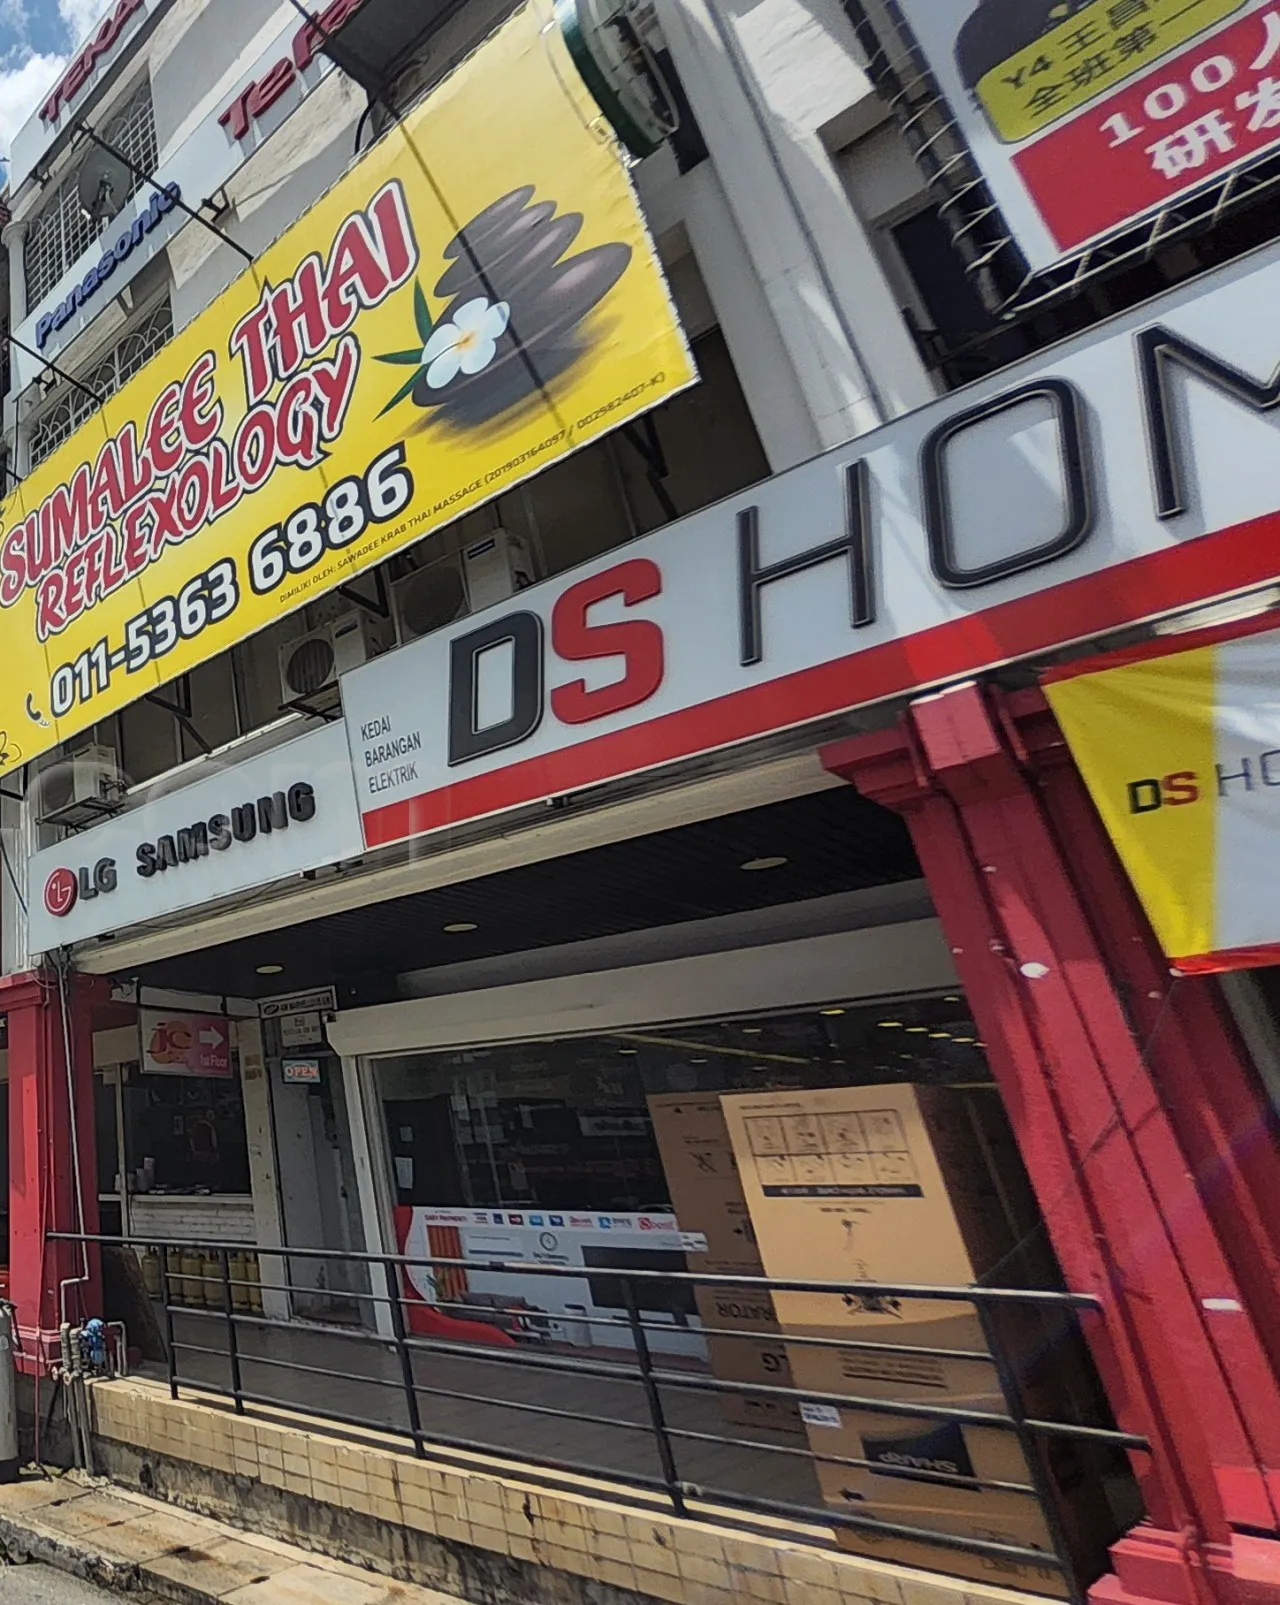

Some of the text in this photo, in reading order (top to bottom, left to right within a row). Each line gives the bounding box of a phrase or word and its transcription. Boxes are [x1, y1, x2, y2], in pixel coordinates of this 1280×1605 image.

[35, 181, 182, 349] Panasonic
[0, 178, 419, 608] SUMALEE THAI
[35, 331, 361, 644] REFLEXOLOGY
[280, 581, 311, 603] DIMILIKI
[312, 566, 337, 585] OLEH:
[337, 538, 379, 569] SAWADEE
[381, 524, 407, 545] KRAB
[407, 511, 432, 532] THAI
[433, 480, 483, 514] MASSAGE
[50, 441, 414, 717] 011-5363 6886
[448, 558, 664, 768] DS
[361, 715, 391, 741] KEDAI
[365, 732, 422, 767] BARANGAN
[369, 761, 419, 793] ELEKTRIK
[78, 857, 117, 900] LG
[136, 782, 317, 878] SAMSUNG
[1127, 771, 1199, 814] DS
[286, 1067, 317, 1078] OPEN
